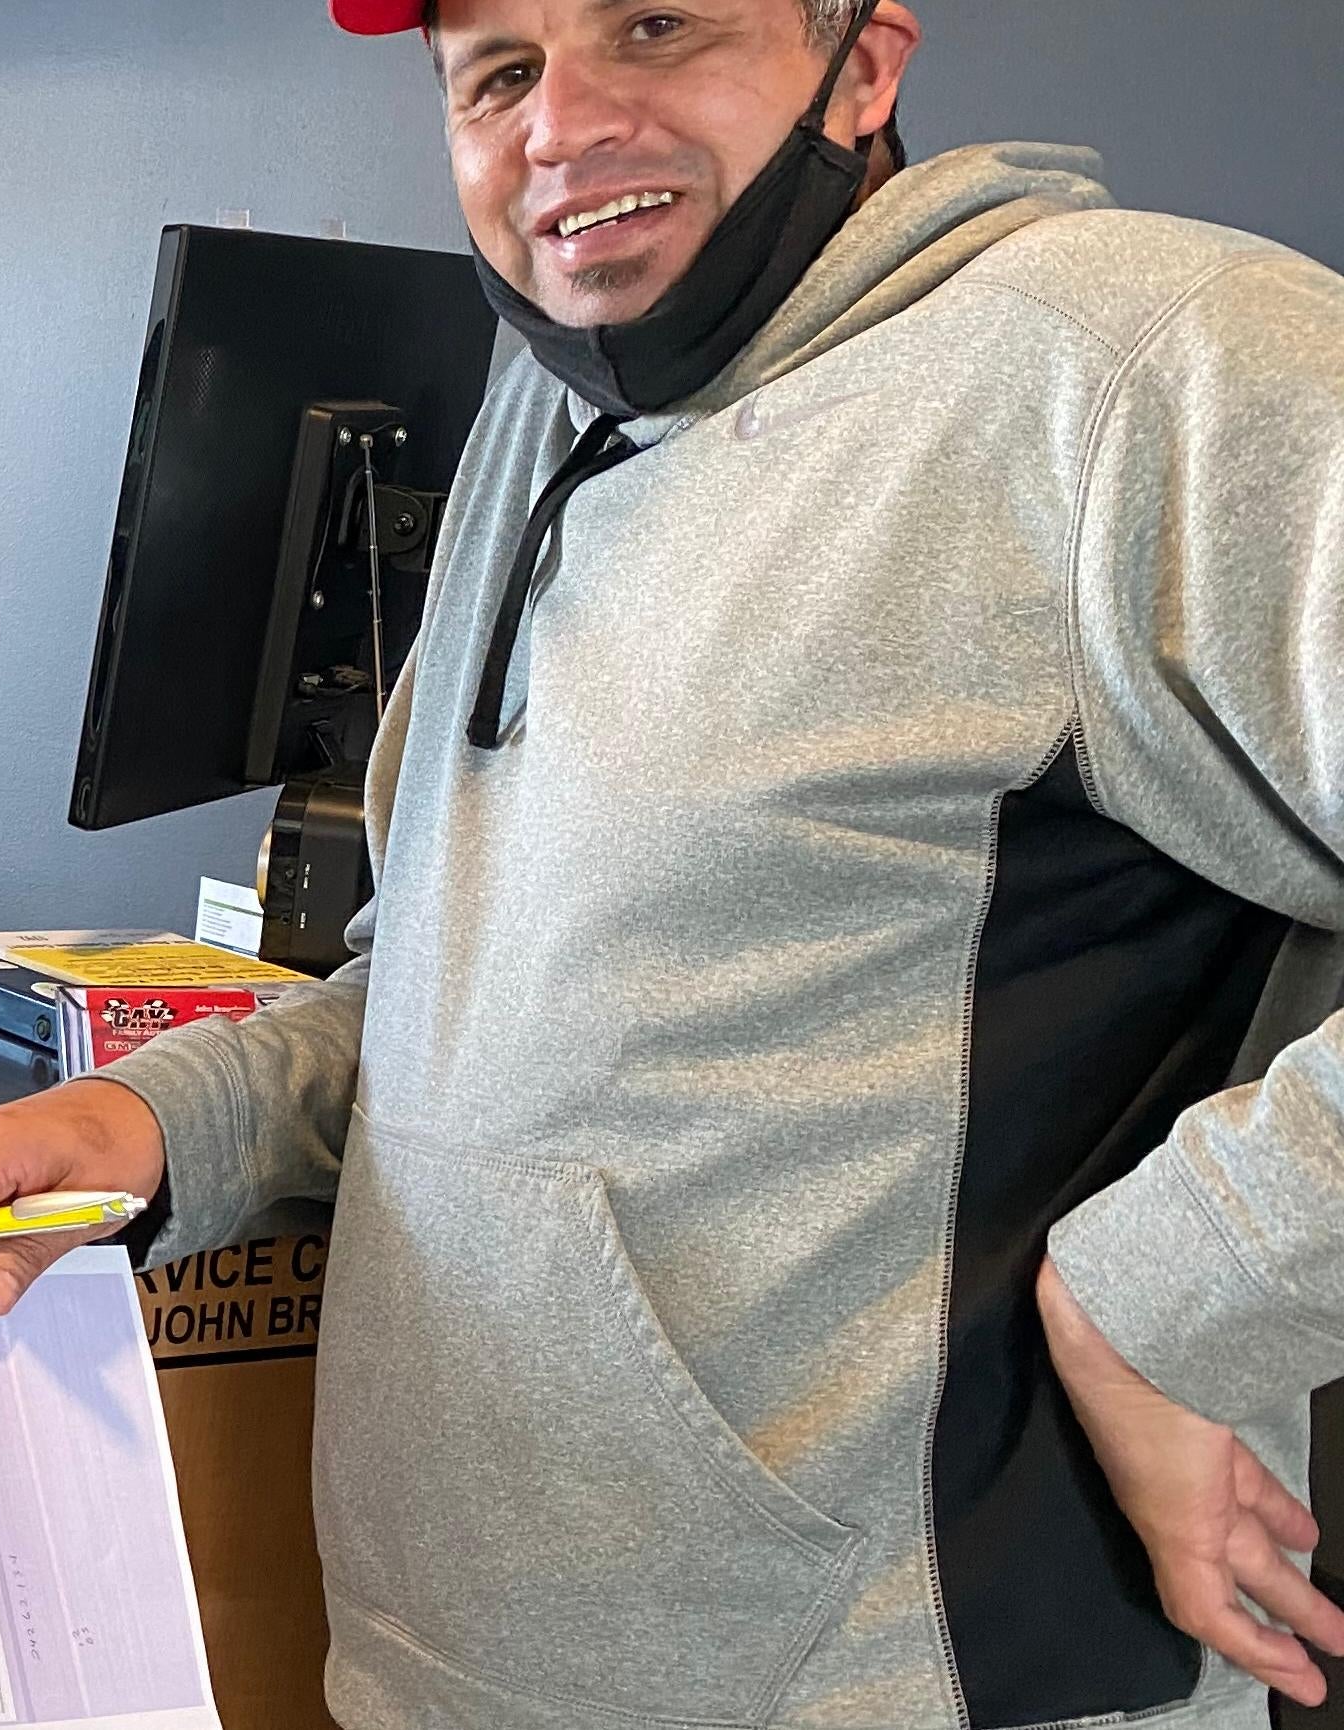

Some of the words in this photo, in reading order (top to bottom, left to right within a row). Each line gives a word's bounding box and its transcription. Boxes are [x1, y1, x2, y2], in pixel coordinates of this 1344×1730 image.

[134, 1237, 277, 1295] VICE
[148, 1299, 256, 1346] JOHN
[268, 1295, 324, 1336] BR
